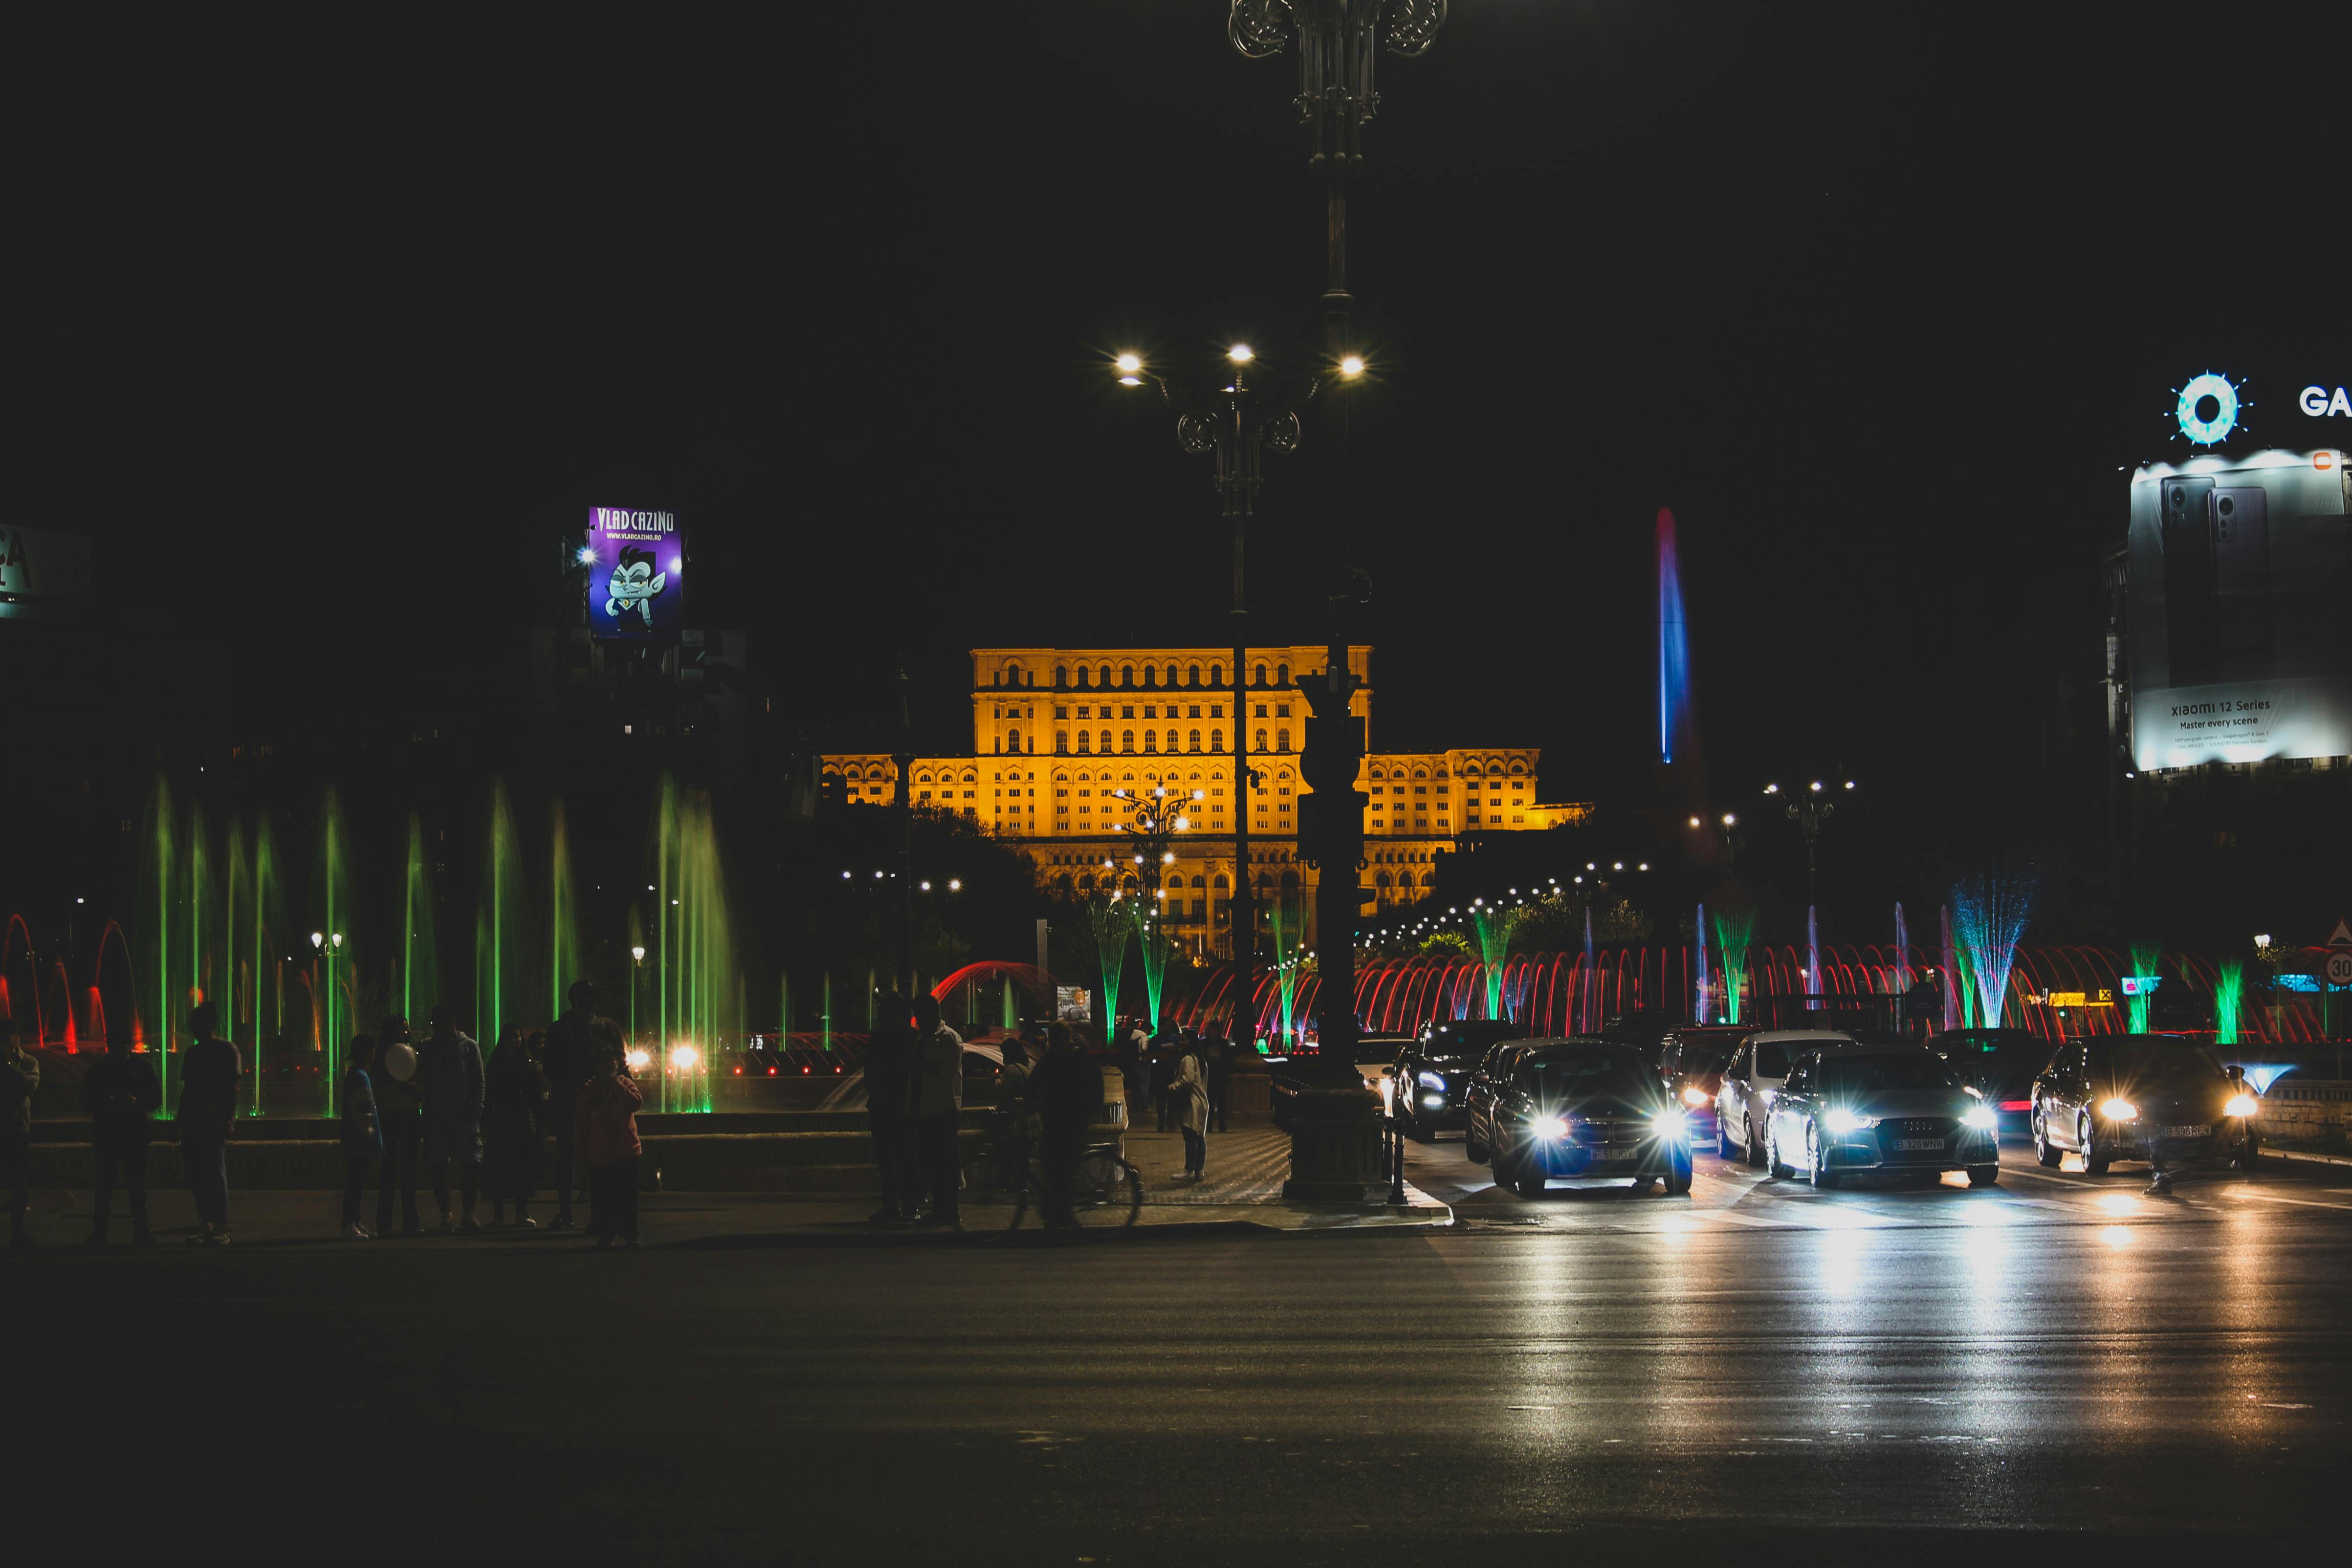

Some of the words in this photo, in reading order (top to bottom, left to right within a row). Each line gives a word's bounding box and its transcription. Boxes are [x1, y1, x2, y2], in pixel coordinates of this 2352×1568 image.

[597, 508, 630, 532] VLAD
[631, 511, 674, 535] CAZINO
[606, 533, 662, 541] WWW.VLADCAZINO.RO
[2220, 701, 2232, 712] 12
[2236, 700, 2270, 711] Series
[2180, 721, 2205, 730] Master
[2208, 719, 2231, 728] every
[2233, 718, 2258, 726] scene
[2332, 959, 2352, 977] 30
[1616, 1149, 1633, 1158] JOY
